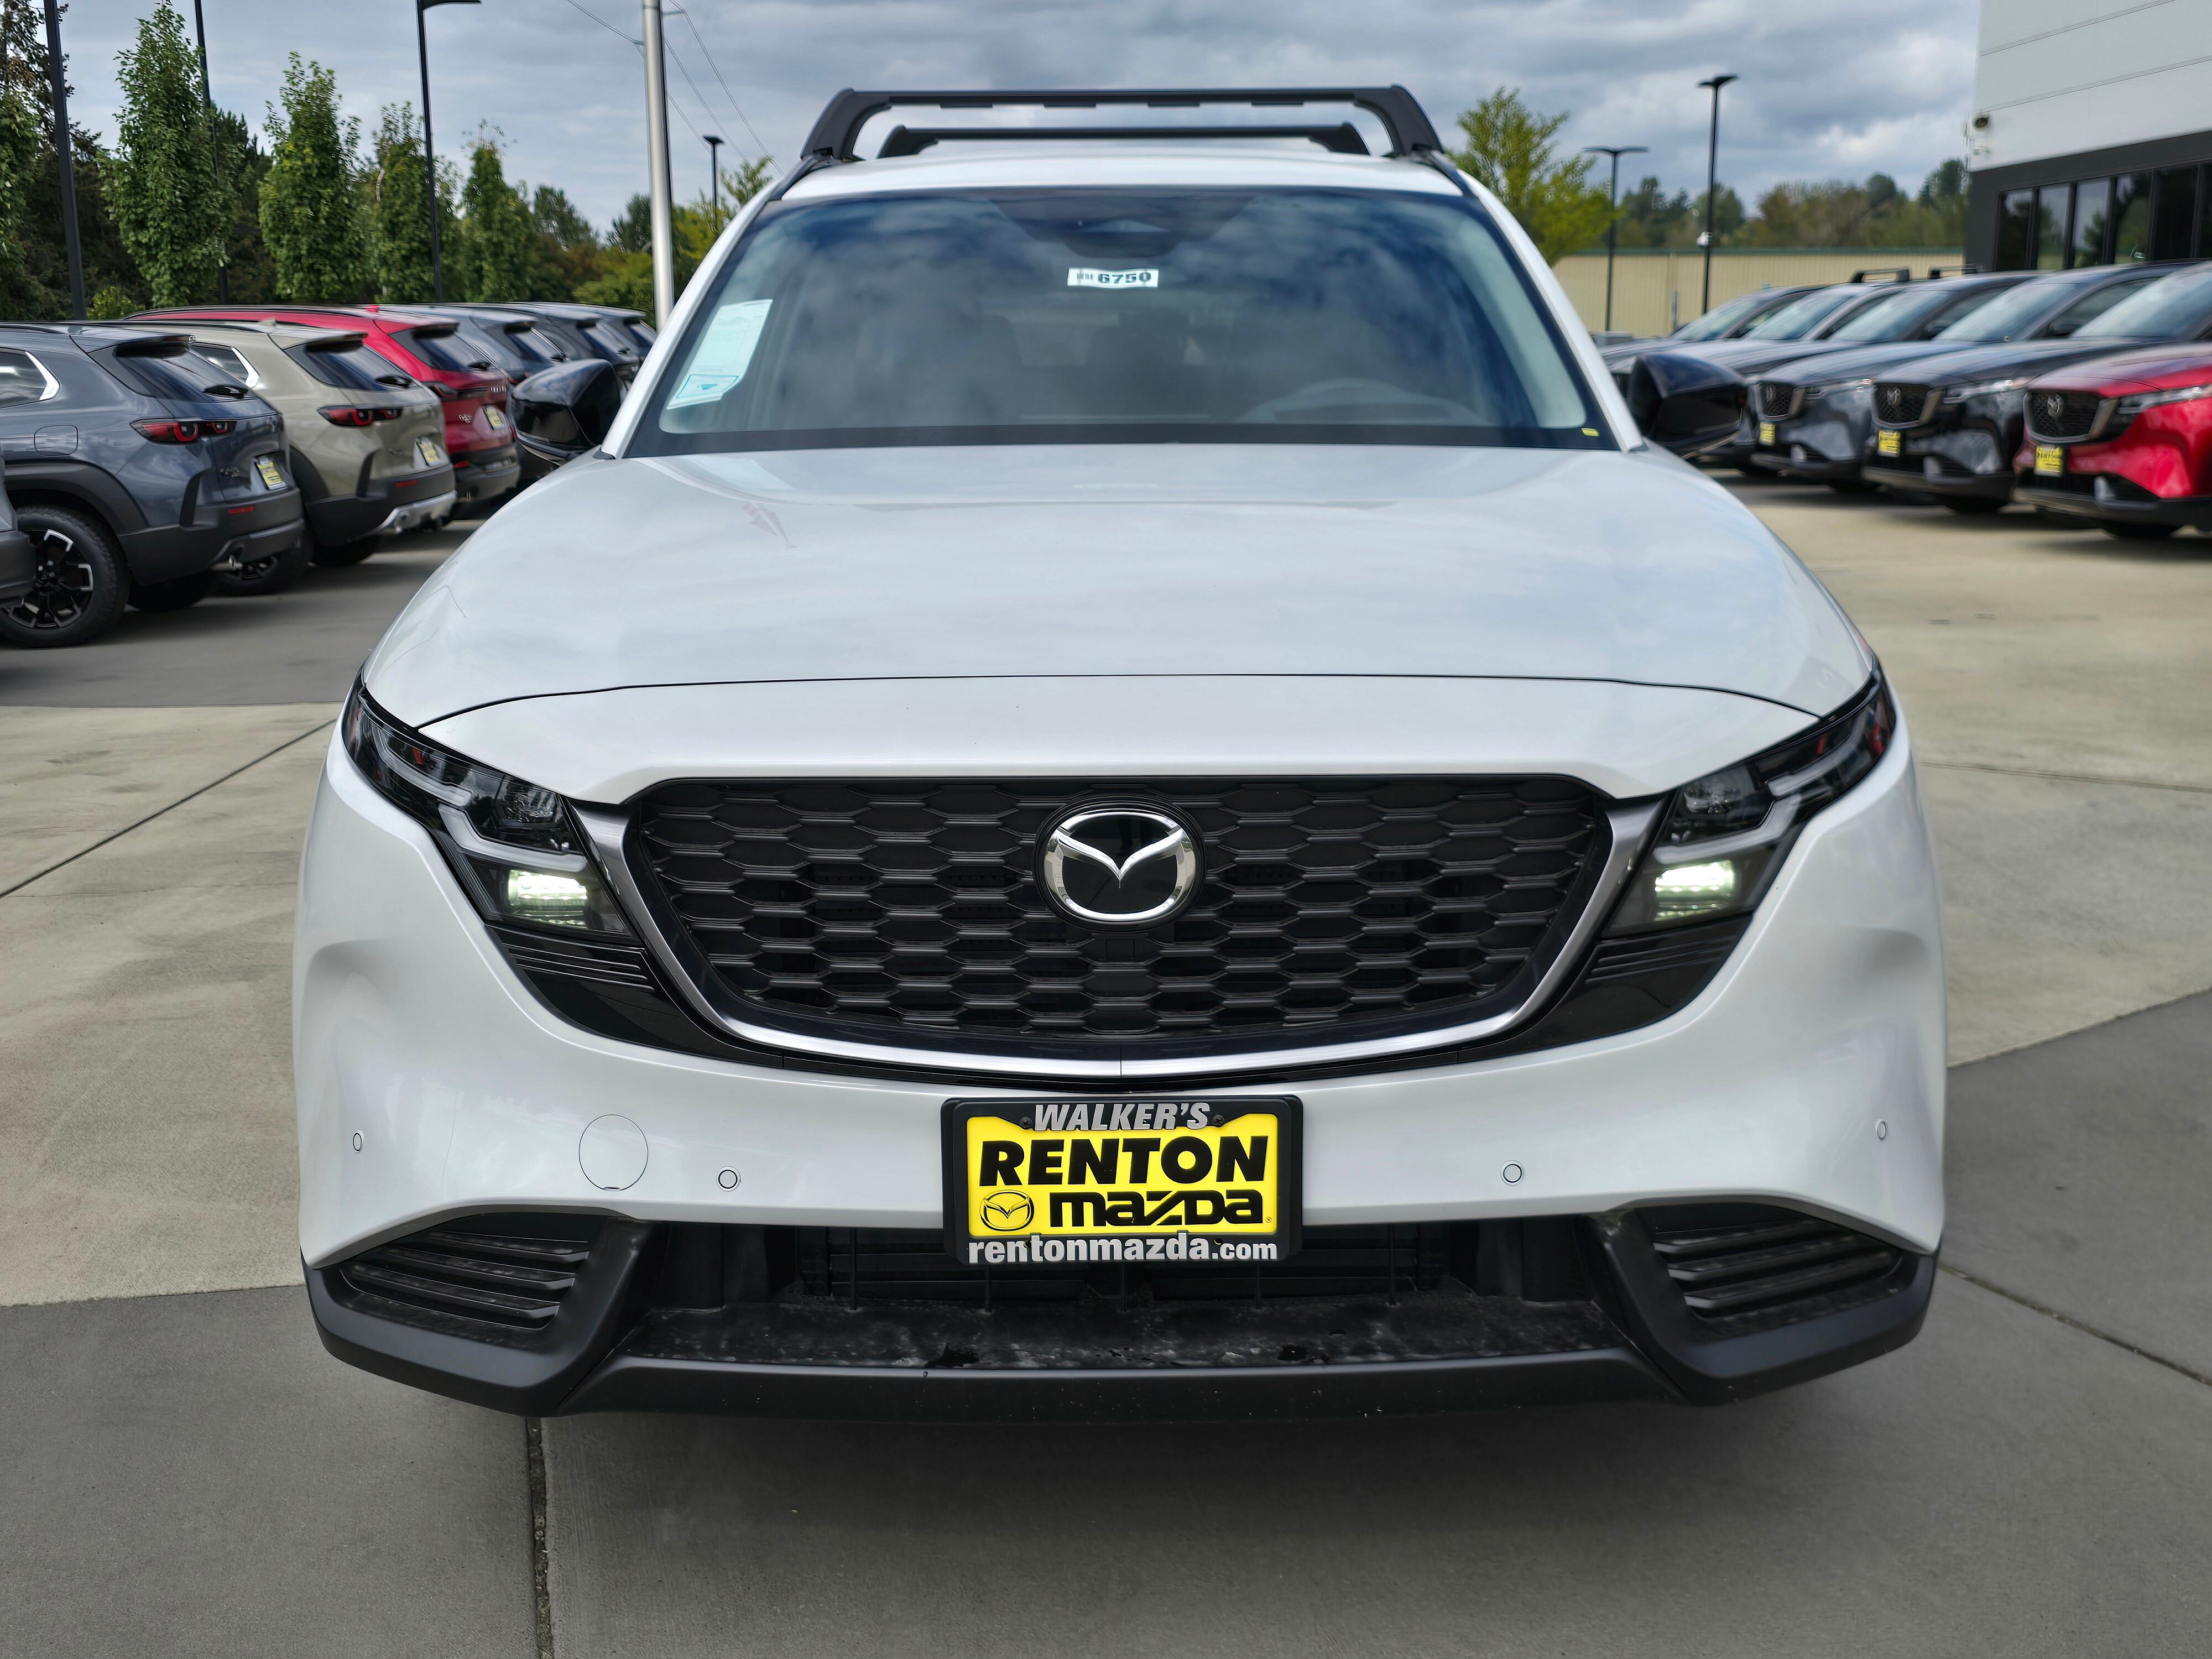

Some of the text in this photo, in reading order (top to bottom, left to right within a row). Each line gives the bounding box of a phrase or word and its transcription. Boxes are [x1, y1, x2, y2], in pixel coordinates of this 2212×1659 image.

[1098, 272, 1151, 284] 6750
[1035, 1103, 1210, 1131] WALKER'S
[979, 1136, 1269, 1187] RENTON
[969, 1233, 1277, 1264] rentonmazda.com
